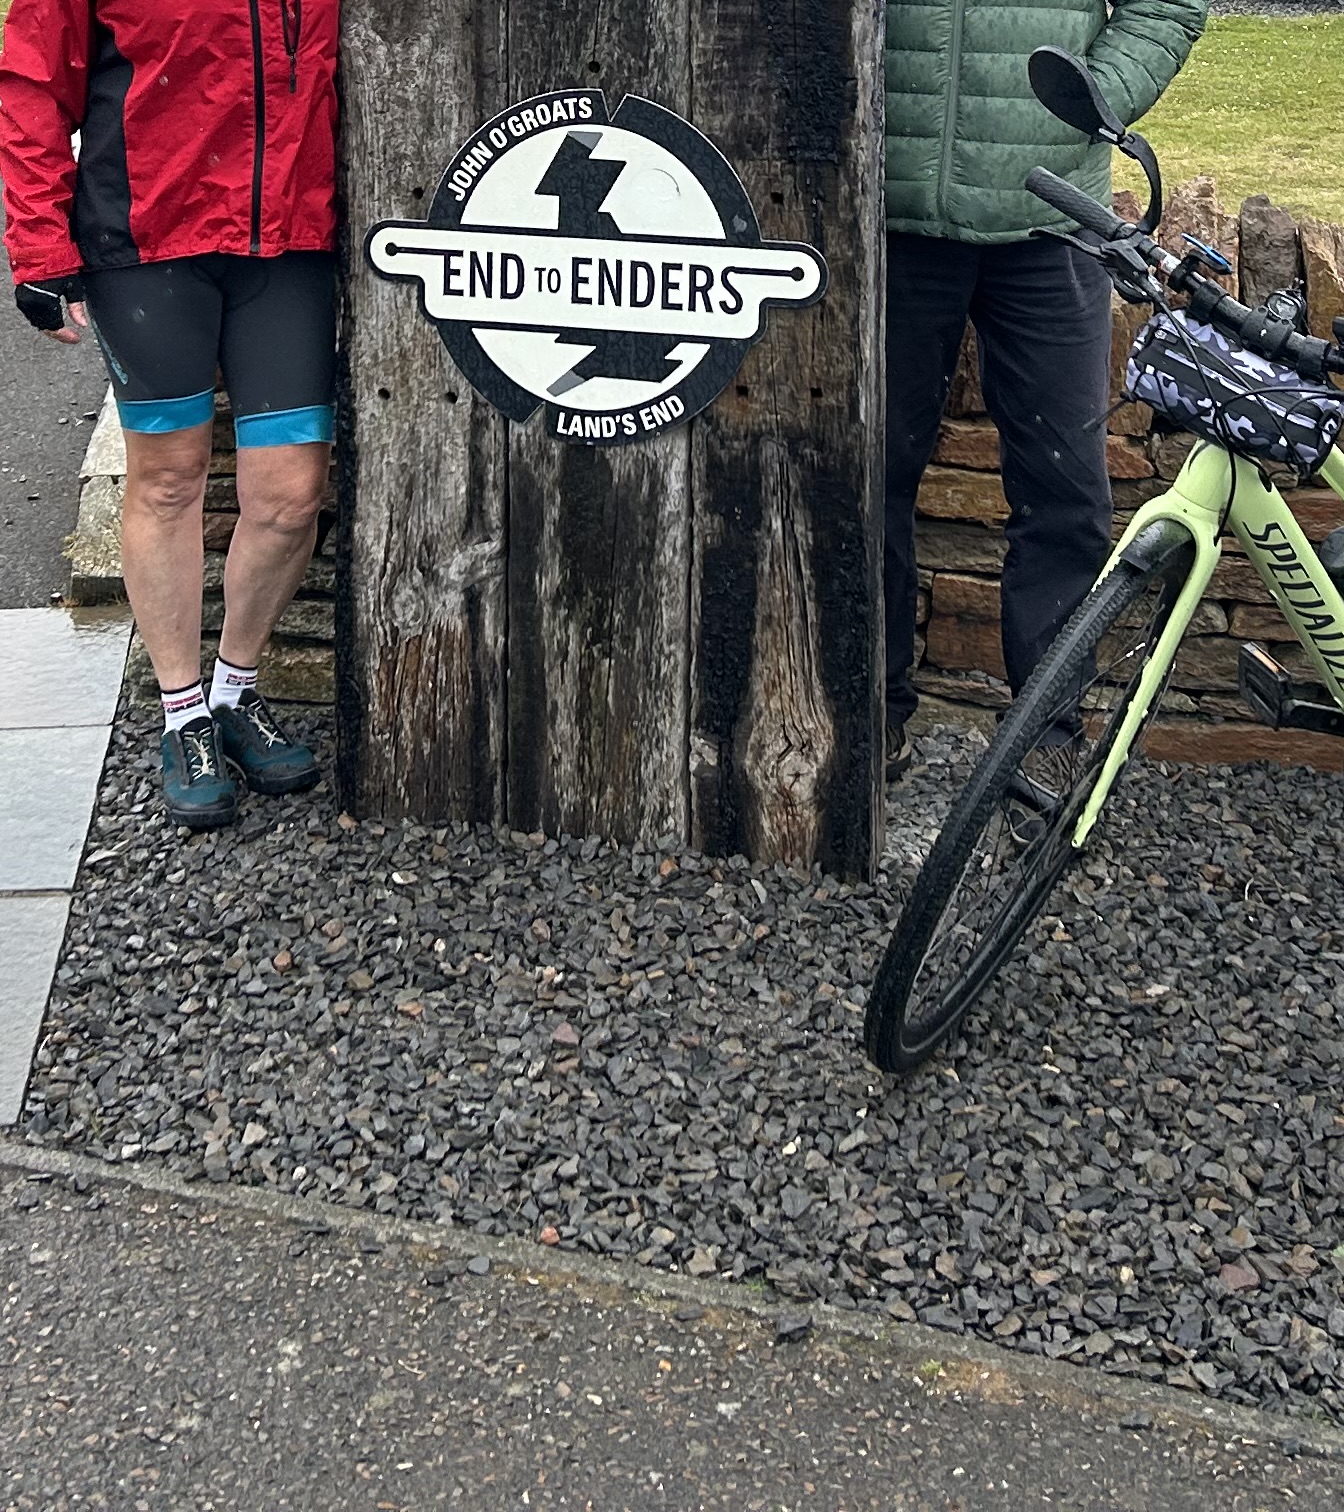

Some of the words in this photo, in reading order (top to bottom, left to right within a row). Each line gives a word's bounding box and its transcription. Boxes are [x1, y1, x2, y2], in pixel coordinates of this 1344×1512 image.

[447, 140, 494, 201] JOHN
[488, 97, 593, 149] O'GROATS
[443, 250, 525, 299] END
[534, 267, 561, 294] TO
[571, 256, 743, 315] ENDERS
[557, 411, 637, 439] LAND'S
[639, 394, 685, 431] END
